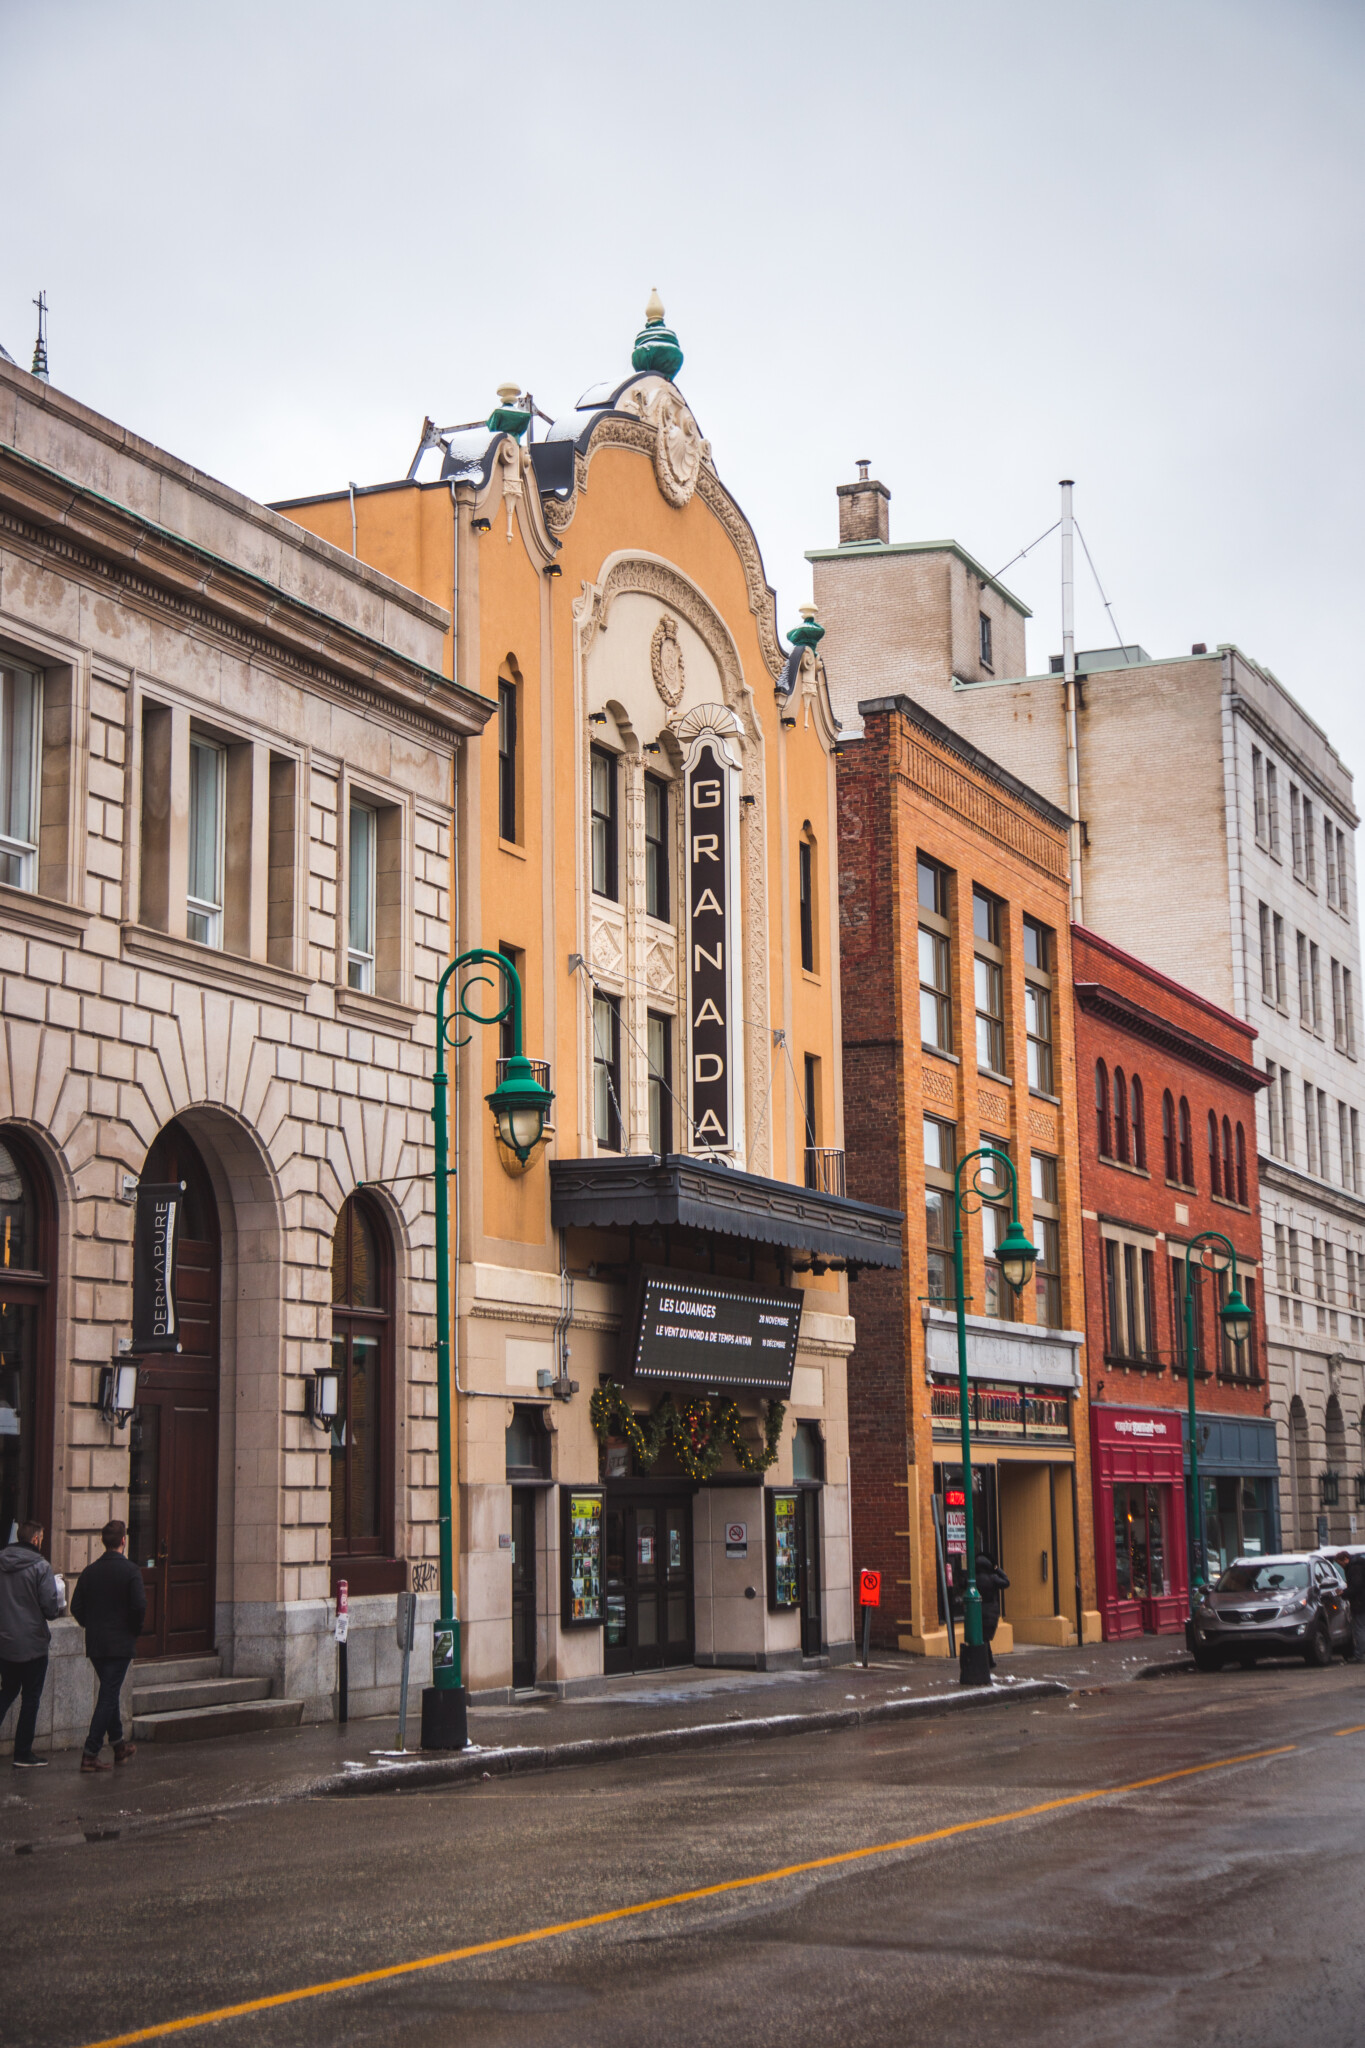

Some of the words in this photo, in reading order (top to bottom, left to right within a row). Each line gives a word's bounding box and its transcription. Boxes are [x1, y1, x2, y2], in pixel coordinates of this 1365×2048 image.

[692, 779, 726, 1138] GRANADA
[659, 1298, 674, 1312] LES
[675, 1300, 716, 1318] LOUANGES
[765, 1315, 789, 1327] NOVEMBRE
[655, 1325, 664, 1336] LE
[664, 1325, 680, 1337] VENT
[680, 1327, 688, 1339] DU
[688, 1328, 705, 1341] NORD
[704, 1331, 709, 1341] &
[709, 1331, 717, 1343] DE
[718, 1333, 735, 1344] TEMPS
[734, 1335, 753, 1346] ANTAN
